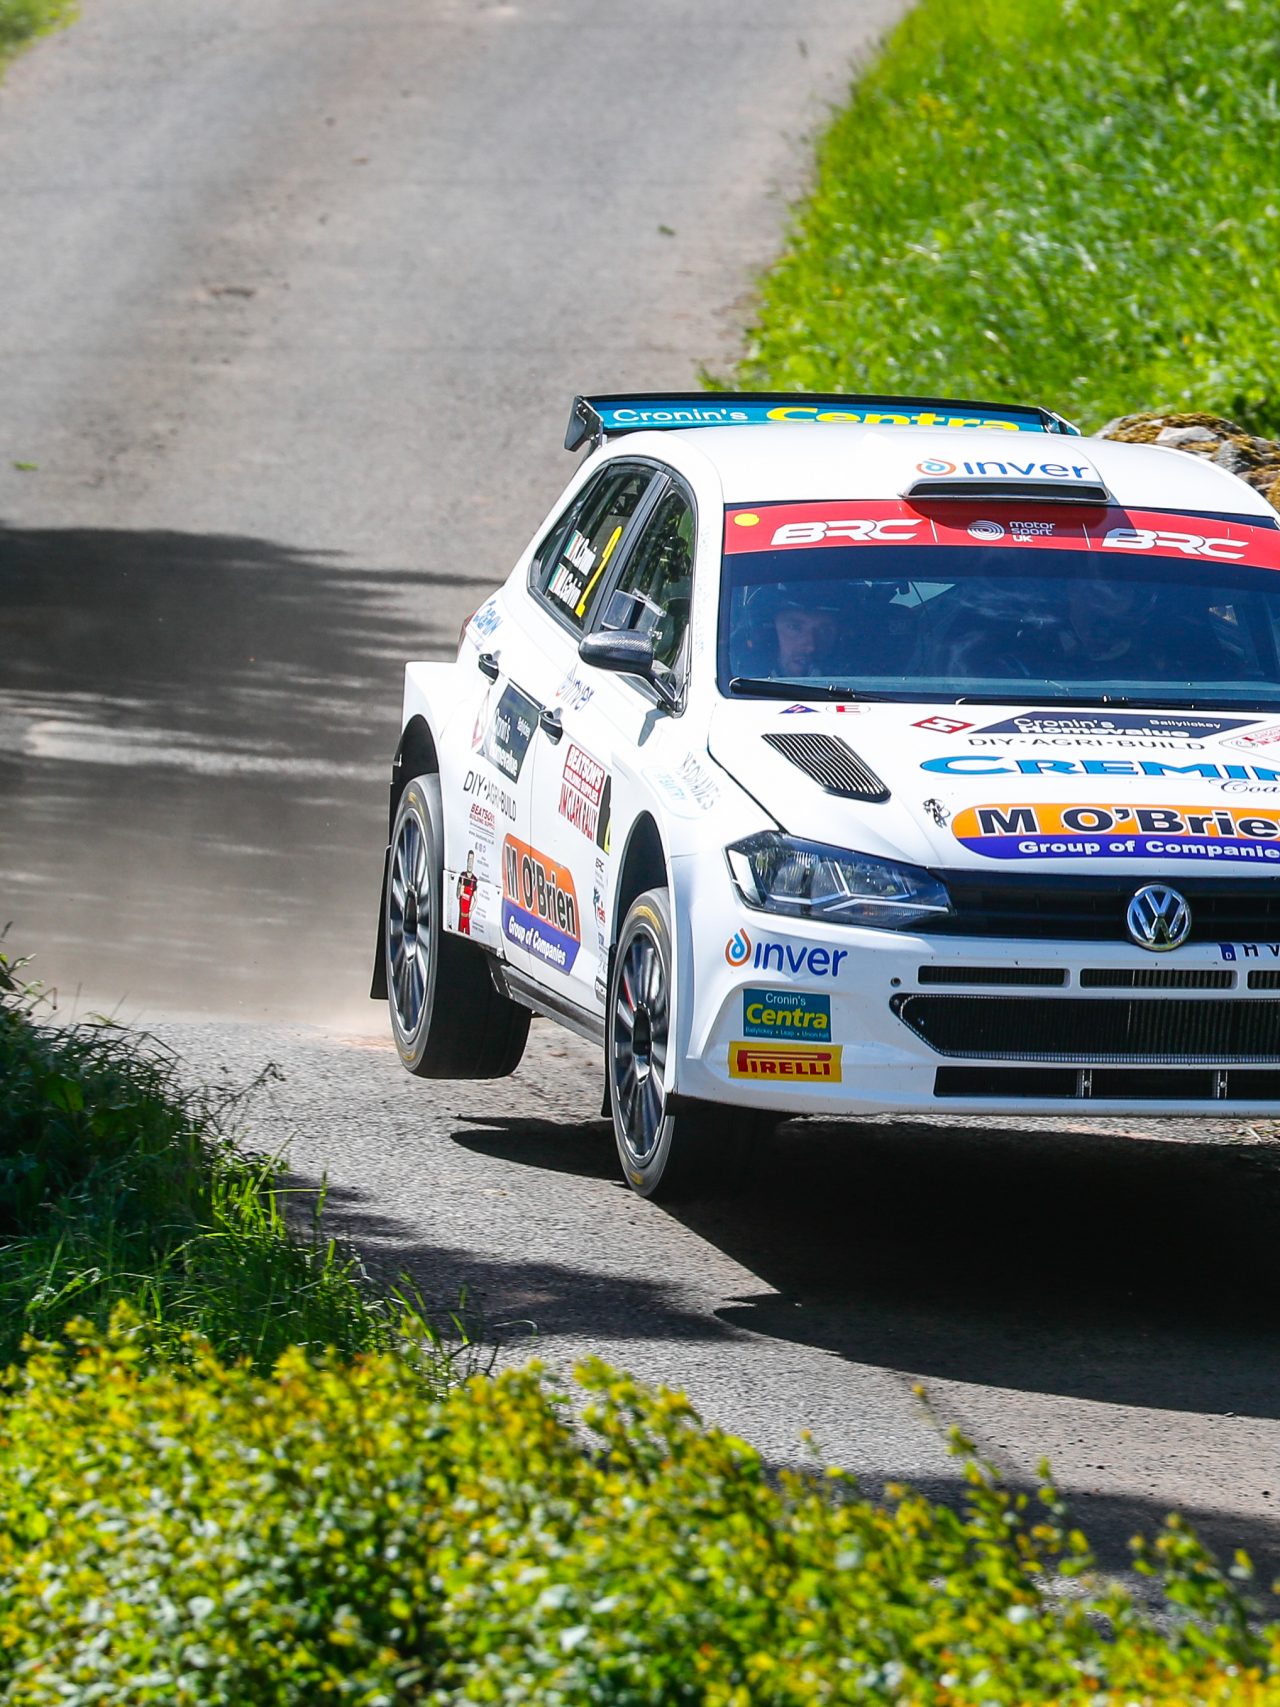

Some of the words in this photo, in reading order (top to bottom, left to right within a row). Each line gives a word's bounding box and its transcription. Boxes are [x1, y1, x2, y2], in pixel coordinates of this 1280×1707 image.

[613, 408, 748, 422] Cronin's
[963, 460, 1089, 478] inver
[770, 518, 923, 546] BRC
[1009, 521, 1056, 530] motor
[1011, 527, 1053, 536] sport
[1012, 534, 1034, 543] UK
[1101, 527, 1249, 560] BRC
[1013, 717, 1115, 729] Cronin's
[1018, 725, 1190, 738] Homevalue
[977, 807, 1041, 836] M
[1018, 840, 1101, 856] Group
[1109, 840, 1136, 853] of
[504, 843, 520, 904] M
[521, 853, 577, 938] O'Brien
[508, 915, 525, 944] Group
[525, 927, 534, 946] of
[532, 932, 567, 967] Companies
[753, 942, 848, 977] inver
[765, 992, 806, 1006] Cronin's
[746, 1003, 828, 1030] Centra
[736, 1049, 832, 1076] PIRELLI
